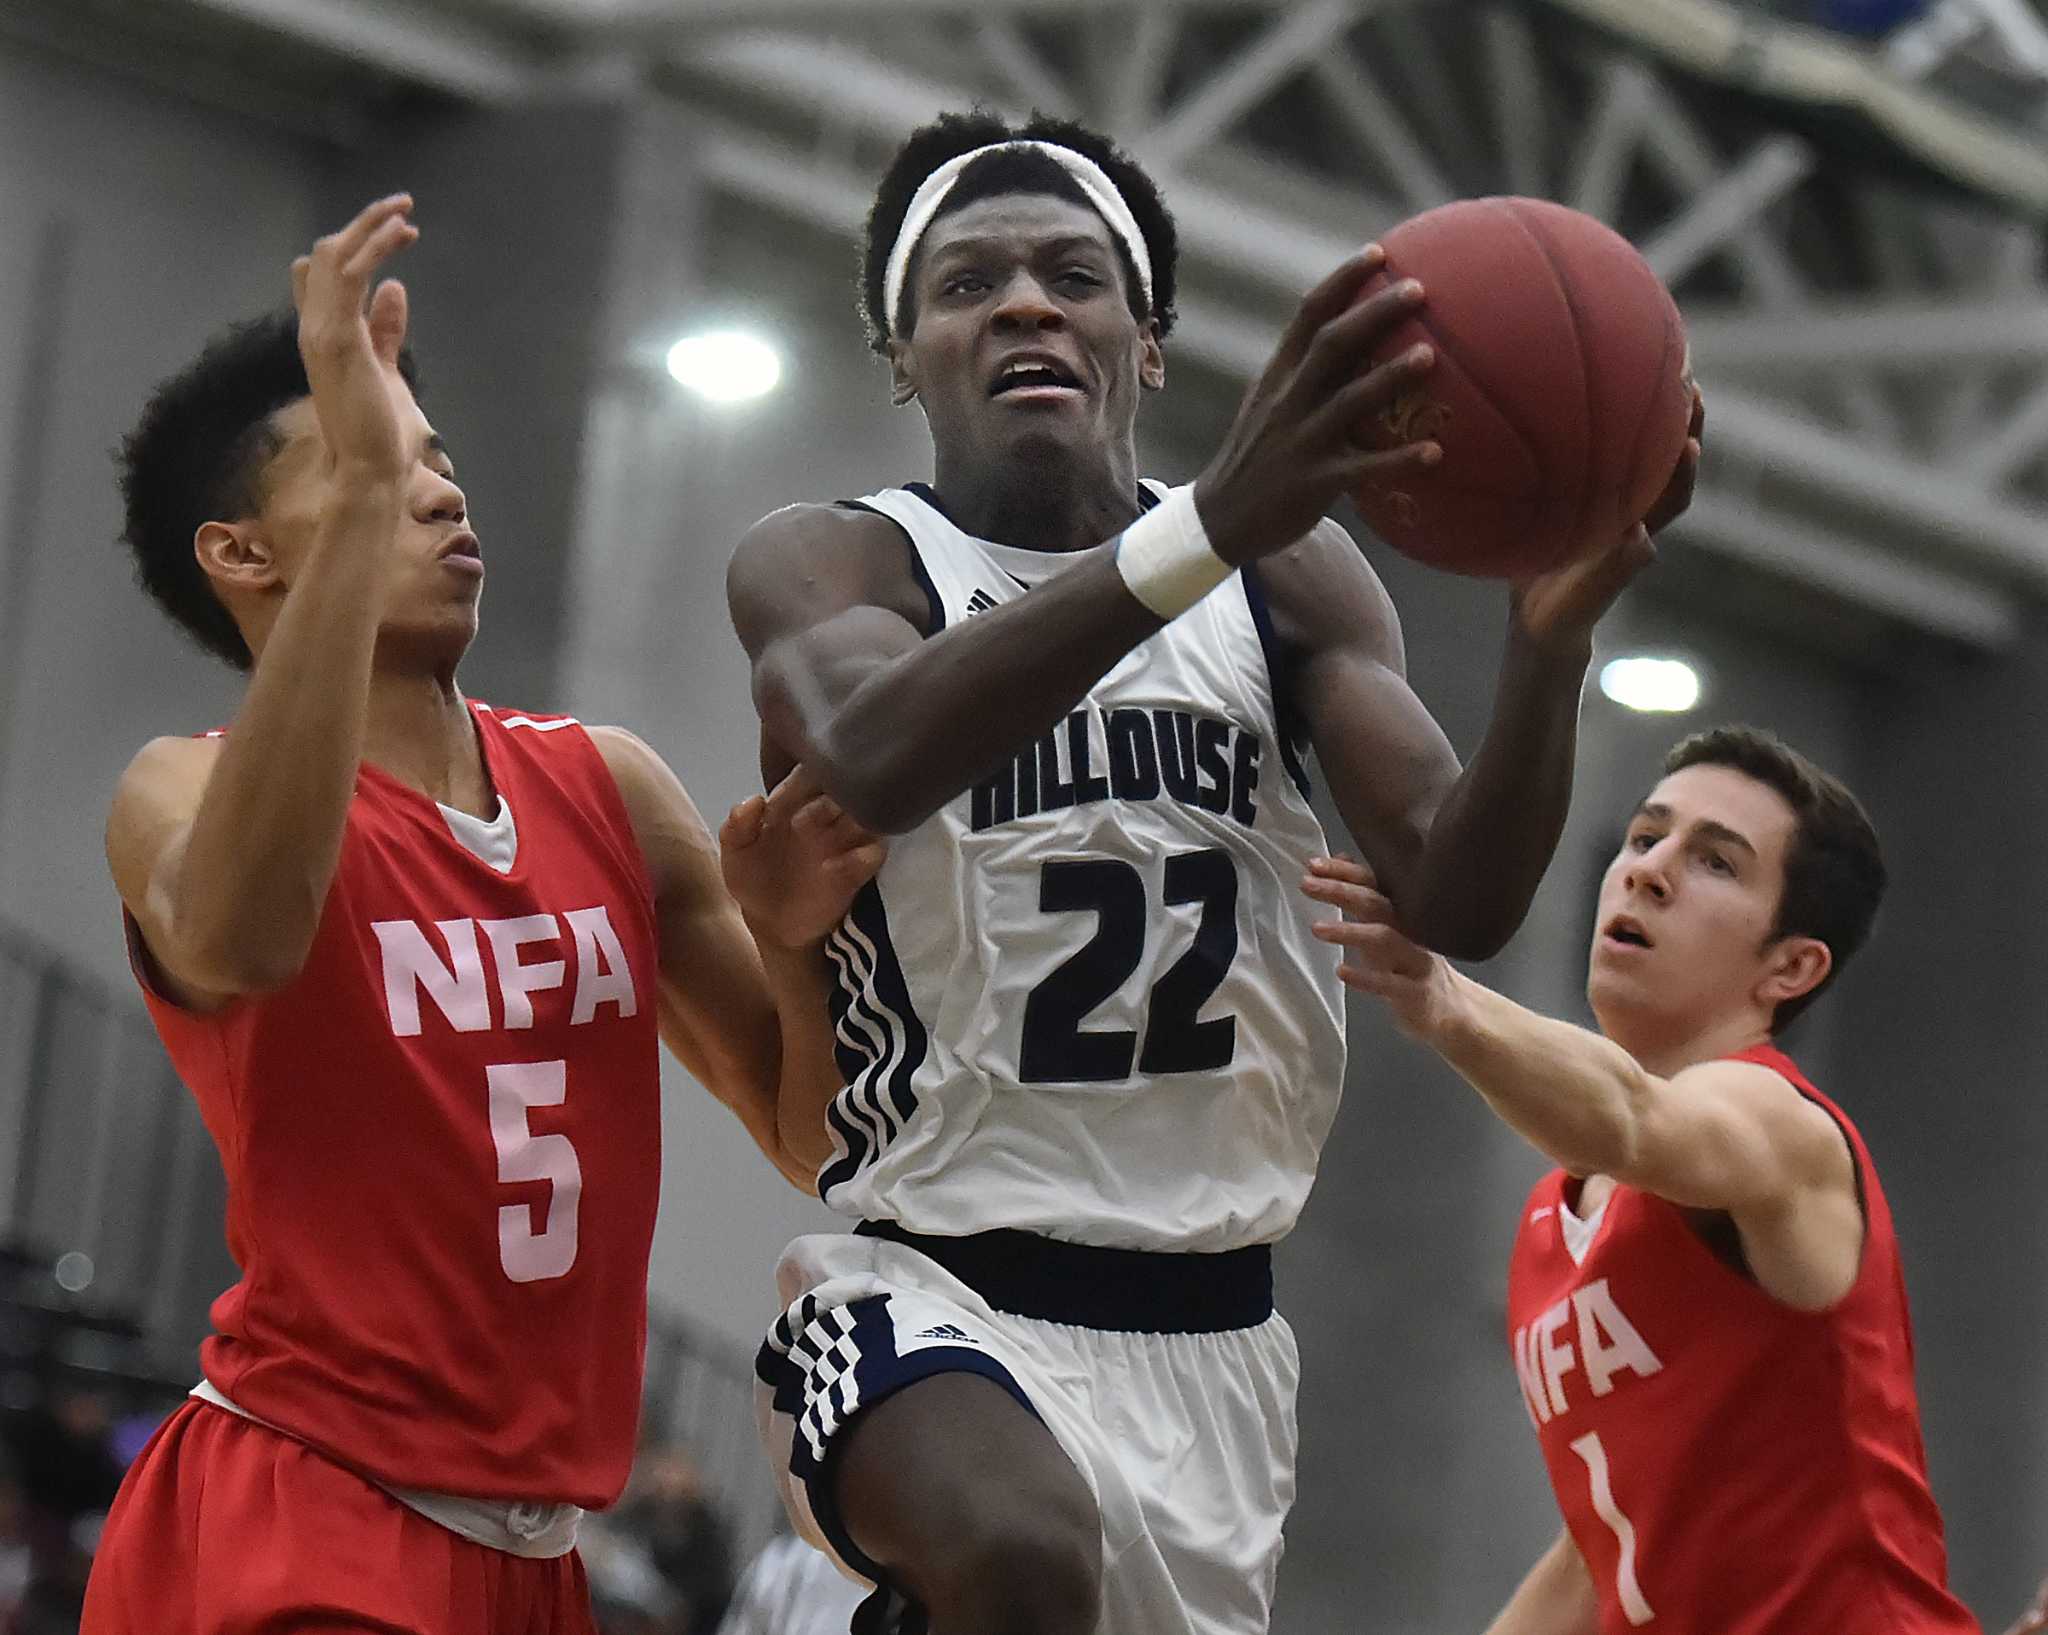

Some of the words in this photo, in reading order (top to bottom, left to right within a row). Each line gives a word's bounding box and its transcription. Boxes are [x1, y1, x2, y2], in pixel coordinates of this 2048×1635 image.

[971, 708, 1259, 833] HILLOUSE
[370, 905, 638, 1037] NFA
[1020, 848, 1238, 1082] 22
[485, 1060, 582, 1283] 5
[1514, 1277, 1664, 1432] NFA
[1569, 1431, 1656, 1627] 1
